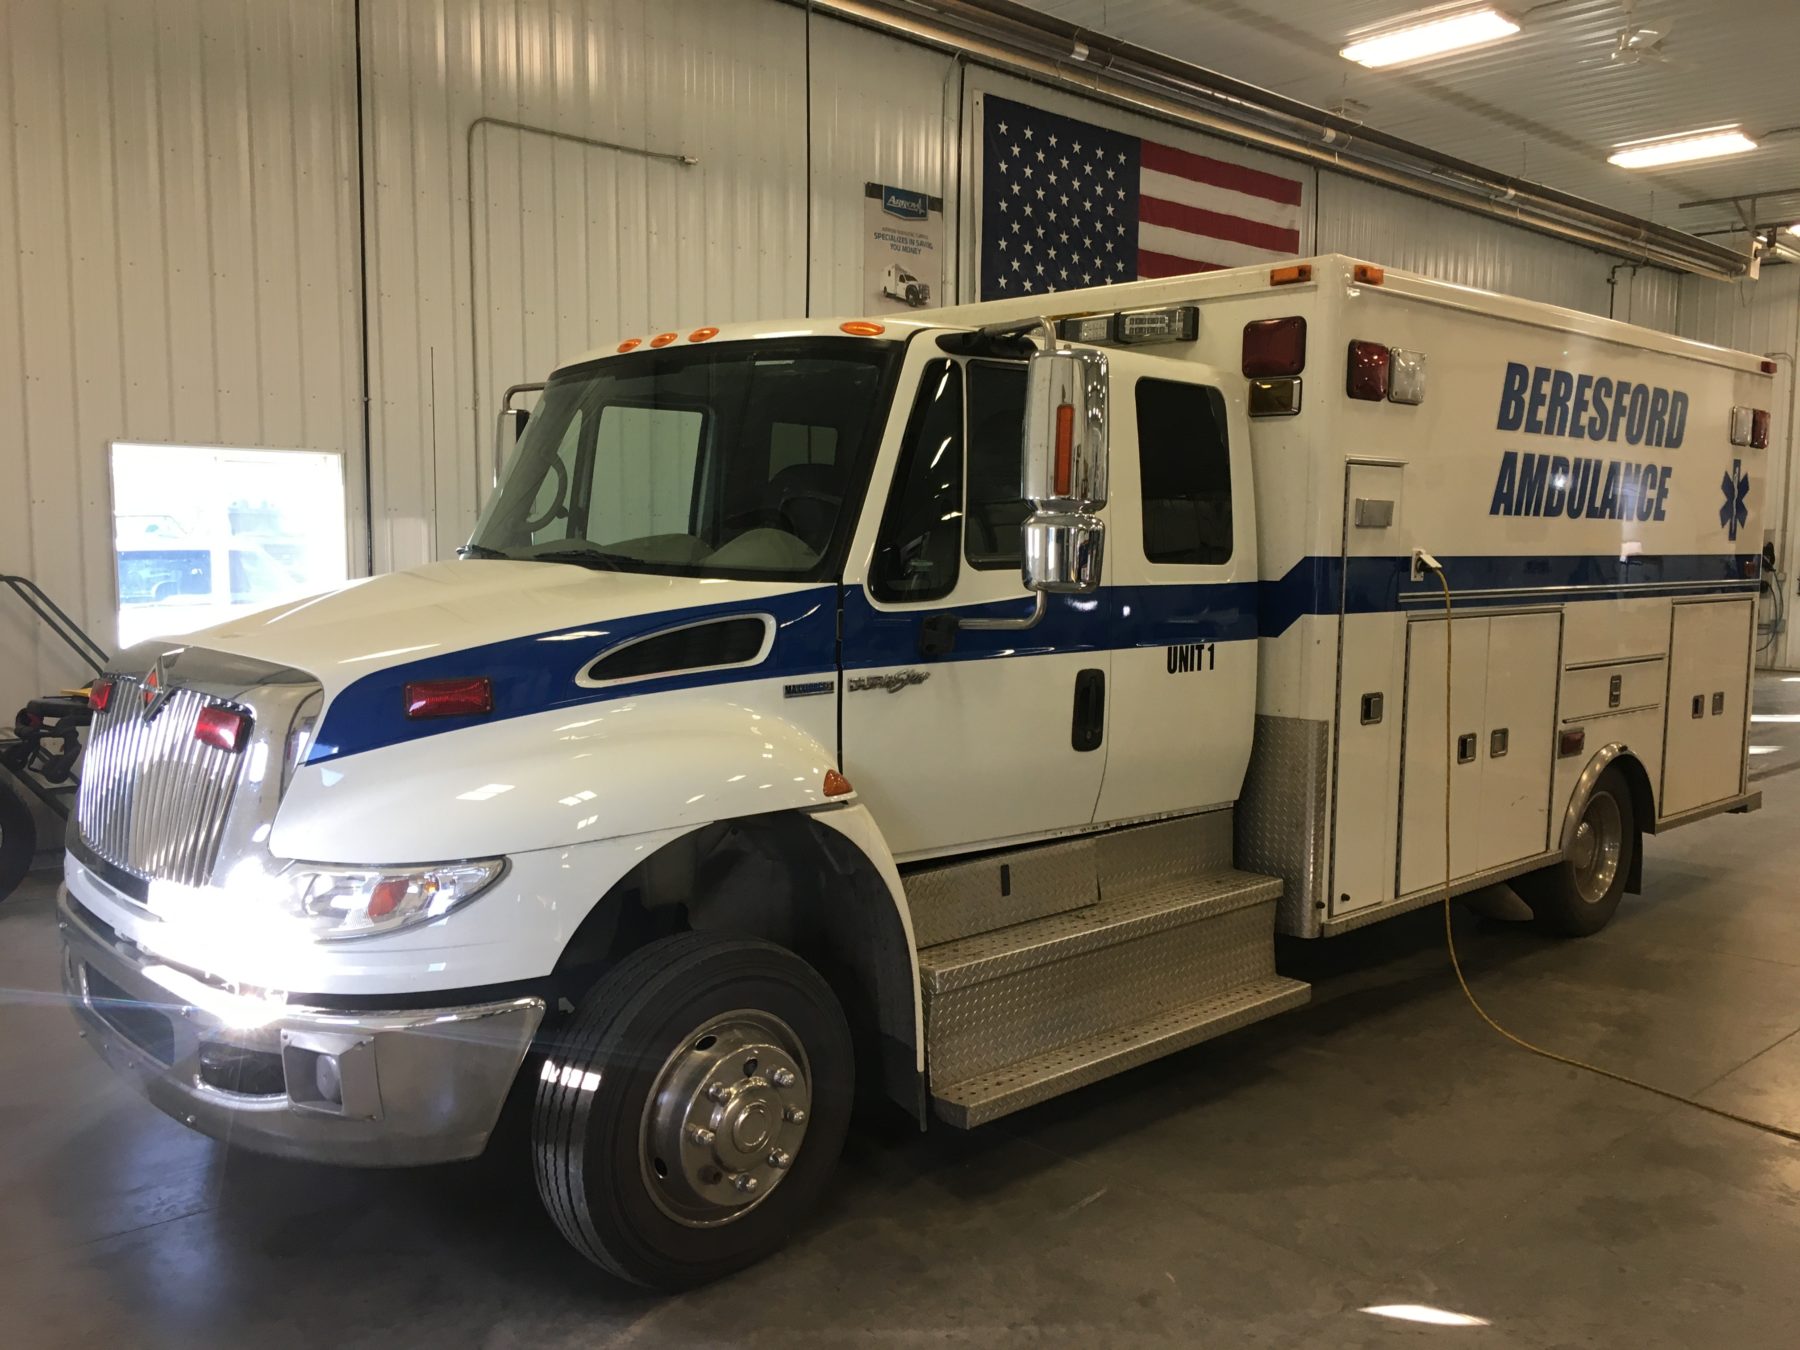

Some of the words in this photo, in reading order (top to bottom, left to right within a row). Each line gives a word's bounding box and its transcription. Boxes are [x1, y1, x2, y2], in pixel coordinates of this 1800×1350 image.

[1496, 361, 1689, 449] BERESFORD
[1489, 450, 1673, 522] AMBULANCE
[1167, 644, 1205, 675] UNIT
[1207, 643, 1215, 671] 1
